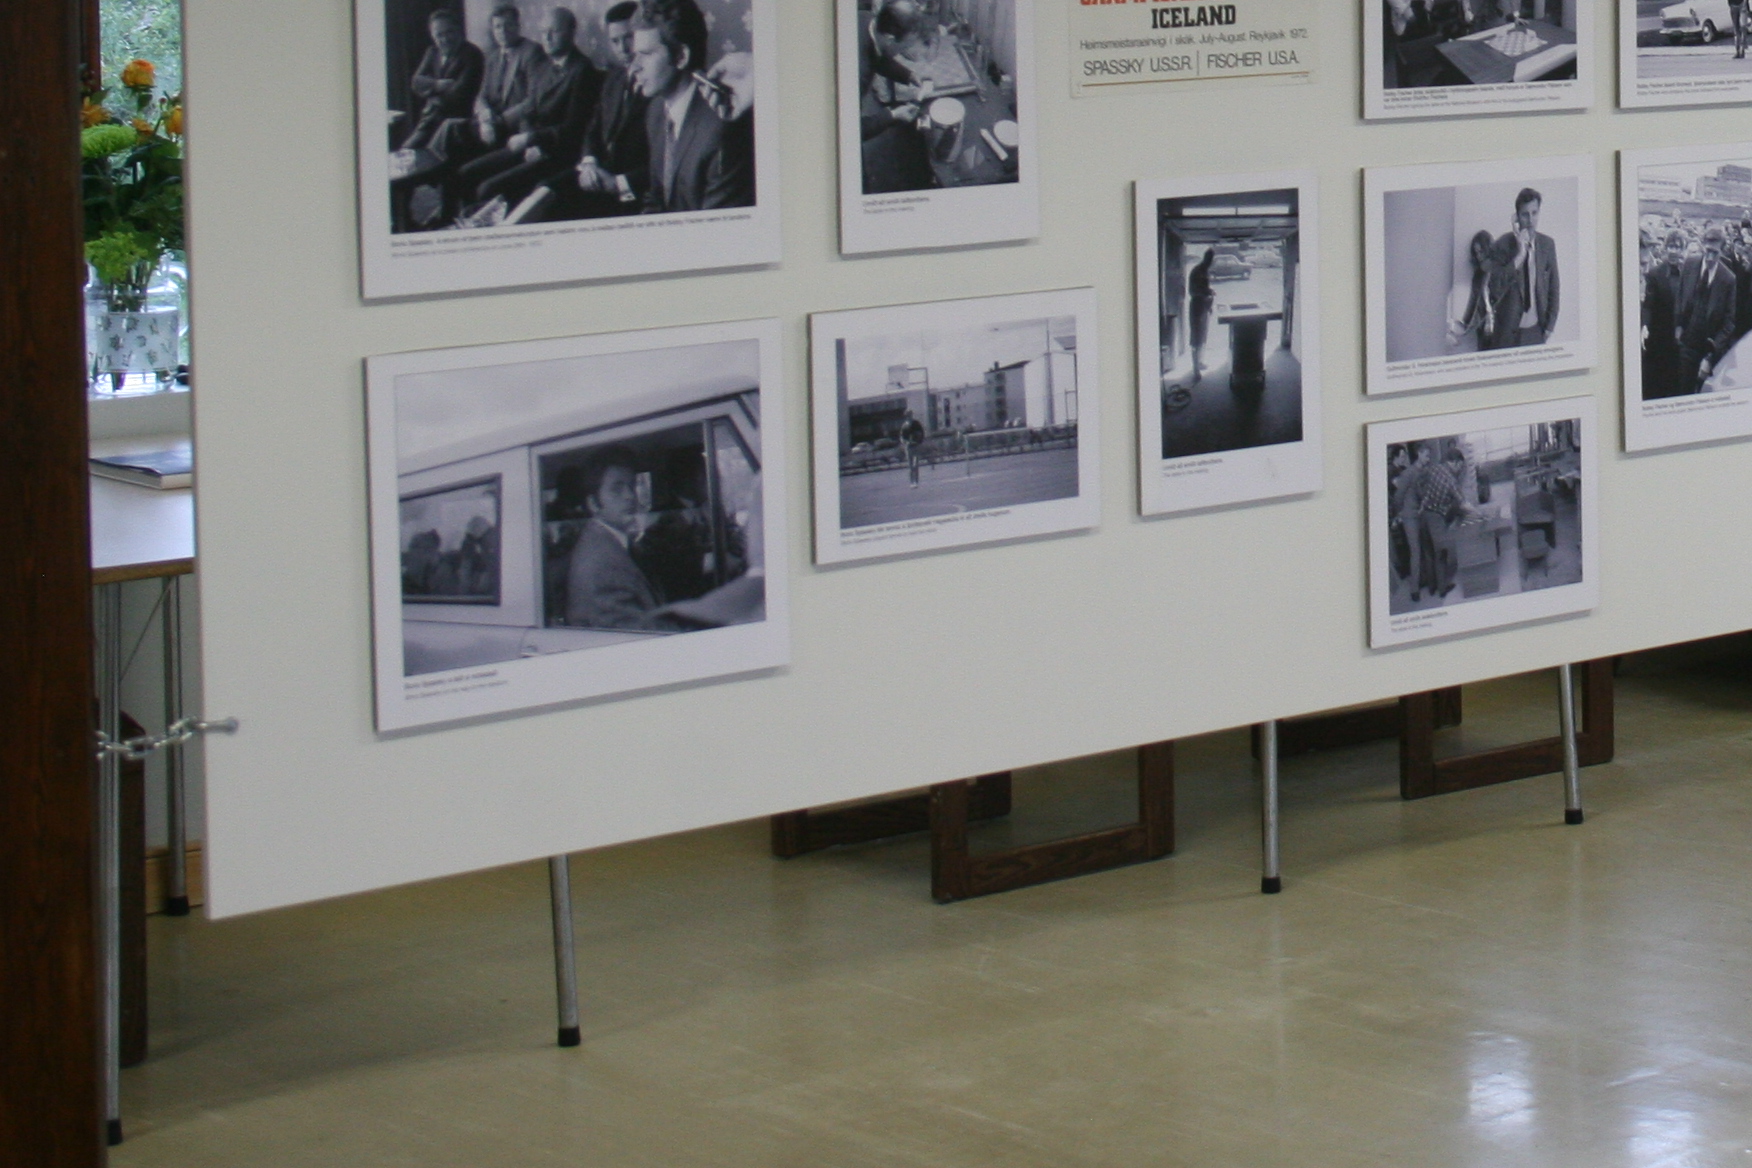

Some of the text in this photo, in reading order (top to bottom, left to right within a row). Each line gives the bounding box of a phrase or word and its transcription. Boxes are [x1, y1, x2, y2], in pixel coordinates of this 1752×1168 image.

[1151, 4, 1236, 30] ICELAND
[1083, 58, 1144, 77] SPASSKY
[1206, 51, 1263, 70] FISCHER
